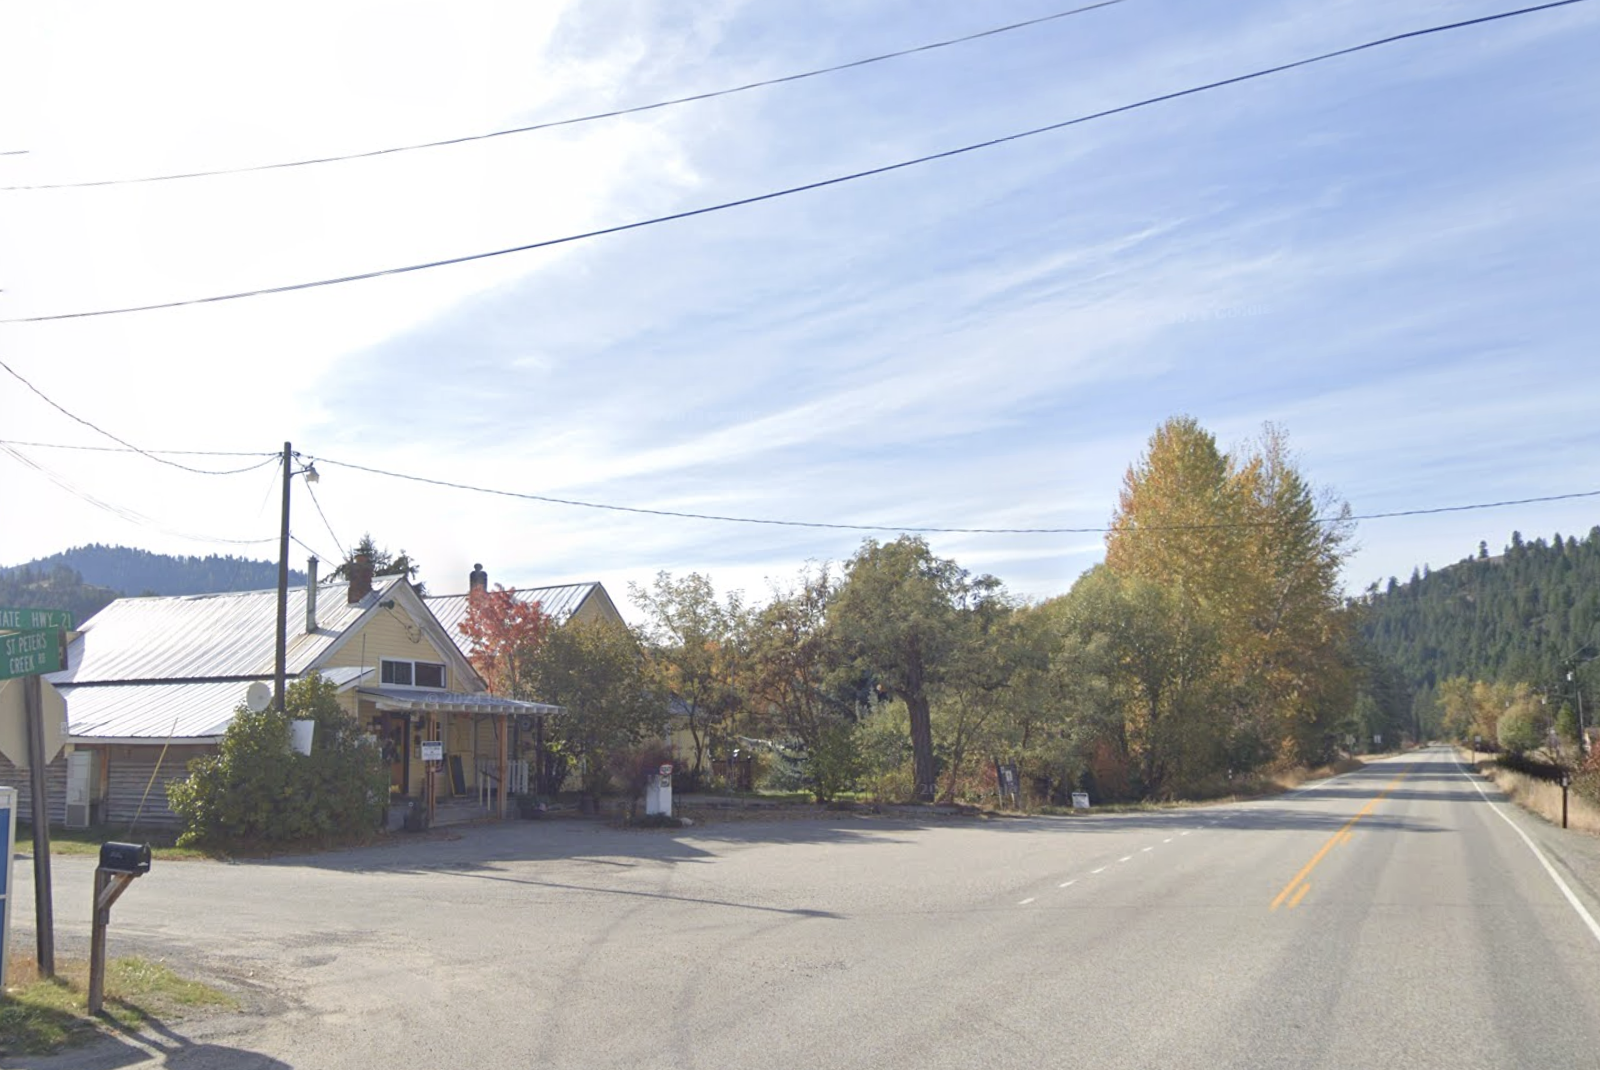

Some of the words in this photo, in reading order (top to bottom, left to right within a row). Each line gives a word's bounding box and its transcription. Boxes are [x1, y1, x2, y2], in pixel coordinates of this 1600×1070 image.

[32, 611, 53, 628] HWY
[61, 611, 71, 628] 21
[6, 638, 16, 656] ST
[19, 632, 47, 653] PETERS
[10, 655, 35, 674] CREEK
